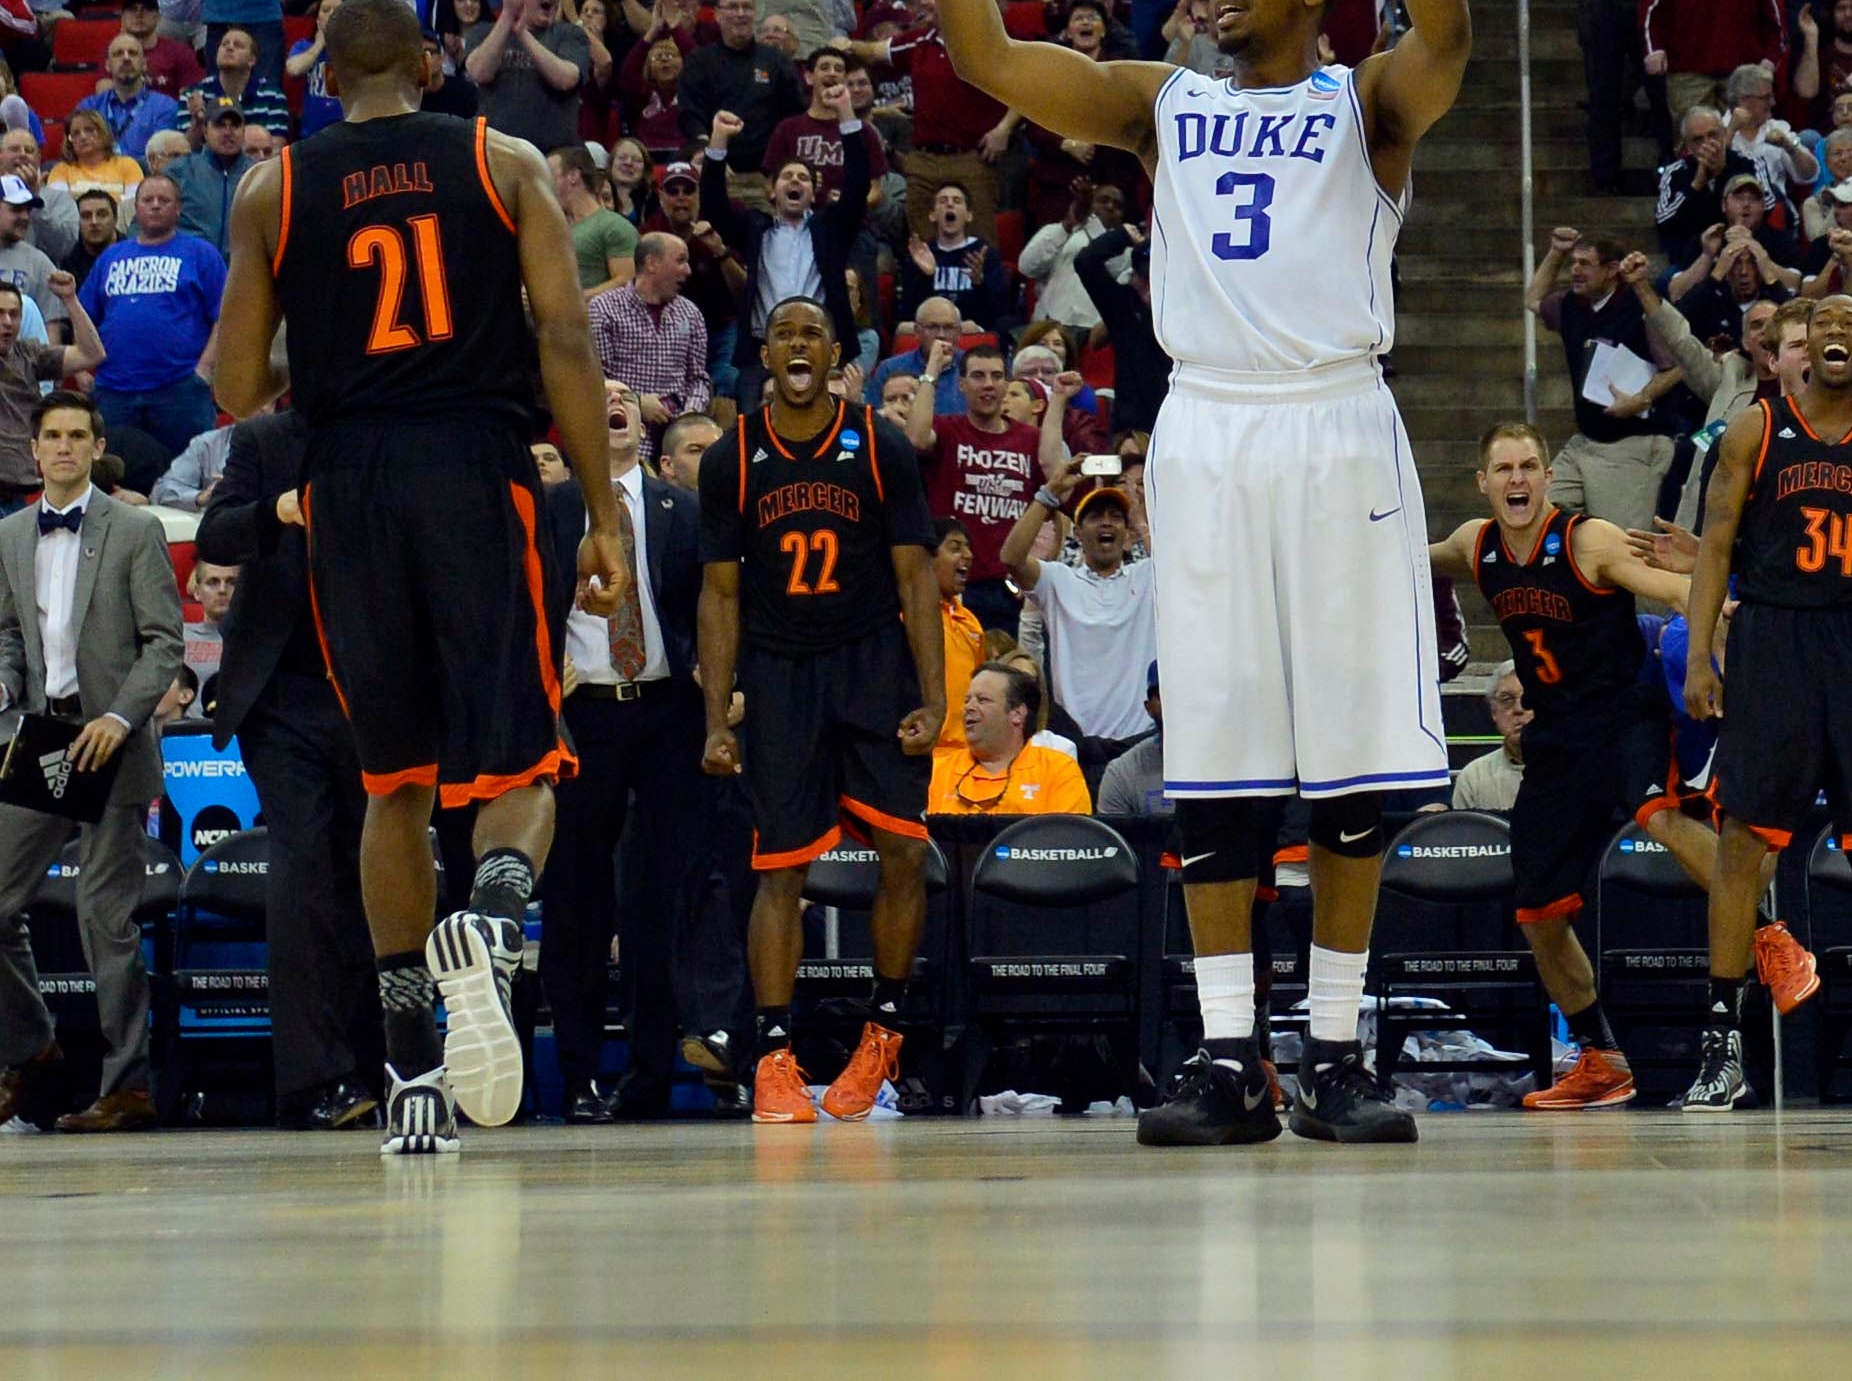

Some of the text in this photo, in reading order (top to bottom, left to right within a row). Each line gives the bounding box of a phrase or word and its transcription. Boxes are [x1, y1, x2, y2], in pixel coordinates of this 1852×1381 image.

[1174, 112, 1336, 164] DUKE
[343, 162, 434, 210] HALL
[1210, 171, 1276, 261] 3
[108, 256, 184, 279] CAMERON
[104, 274, 178, 297] CRAZIES
[347, 212, 454, 356] 21
[759, 480, 860, 529] MERCER
[779, 528, 841, 596] 22
[1490, 586, 1573, 622] MERCER
[1521, 627, 1563, 685] 3
[821, 850, 879, 862] BASKET
[1010, 847, 1103, 861] BASKETBALL
[1412, 845, 1501, 858] BASKETBALL
[219, 862, 269, 874] BASKE
[1272, 961, 1294, 972] FOUR
[1404, 960, 1517, 972] THE ROAD TO THE FINAL FOUR
[1625, 956, 1711, 967] THE ROAD TO THE FIN
[807, 966, 830, 978] ROAD
[830, 966, 842, 978] TO
[842, 966, 859, 978] THE
[859, 966, 874, 978] FIN
[992, 964, 1104, 976] THE ROAD TO THE FINAL FOUR
[57, 981, 69, 993] TO
[69, 980, 84, 993] THE
[192, 976, 208, 989] THE
[208, 976, 231, 988] ROAD
[232, 976, 244, 988] TO
[244, 976, 260, 988] THE
